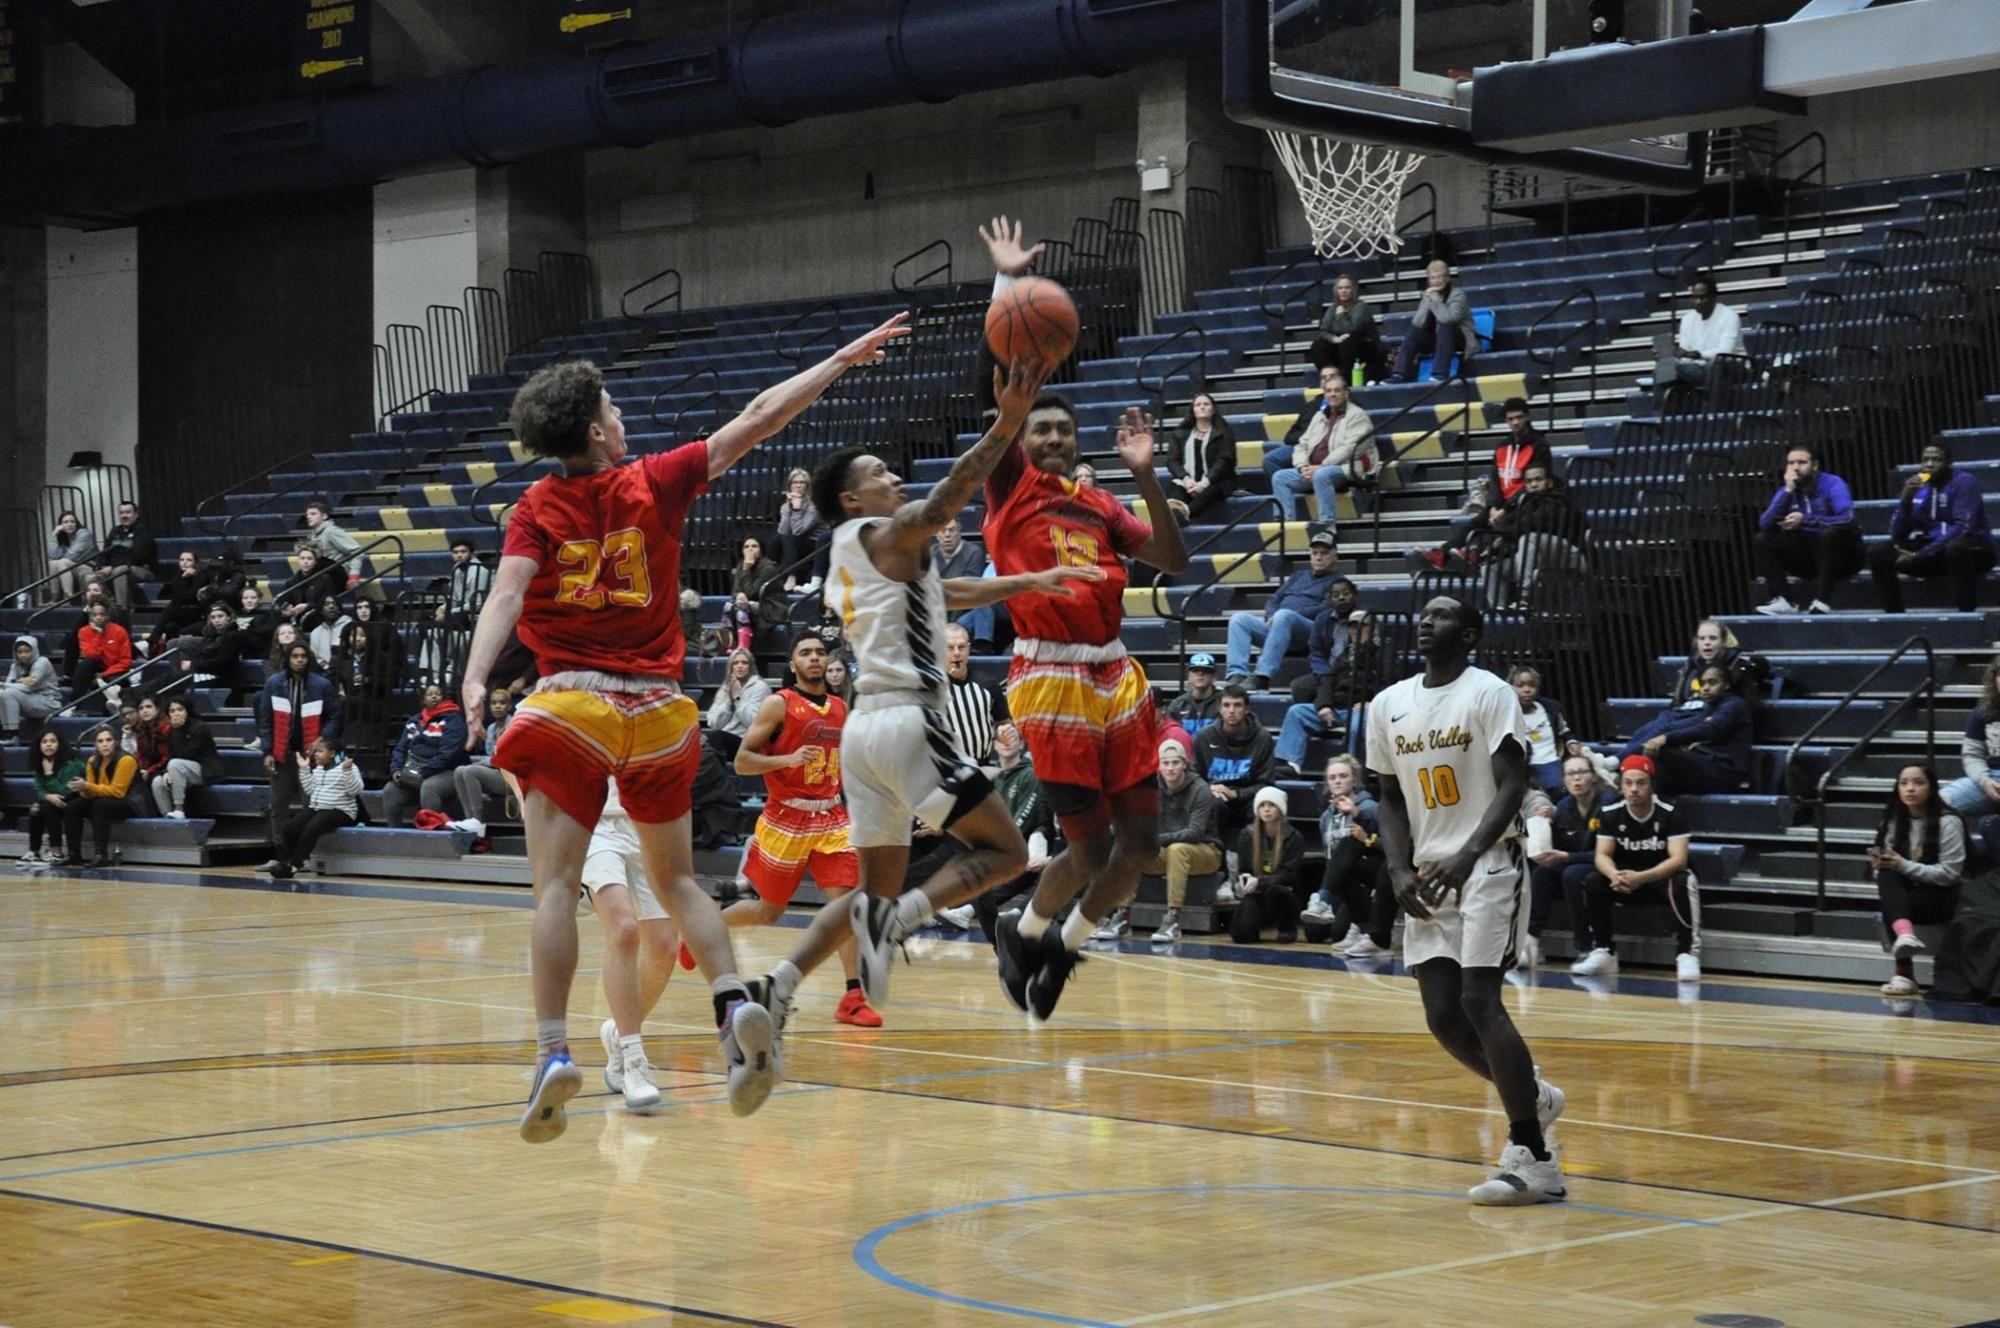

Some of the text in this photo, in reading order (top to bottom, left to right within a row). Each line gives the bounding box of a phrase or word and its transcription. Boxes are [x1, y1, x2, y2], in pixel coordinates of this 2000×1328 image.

[554, 526, 652, 609] 23
[1394, 724, 1473, 756] Rock Valley
[1417, 764, 1460, 810] 10
